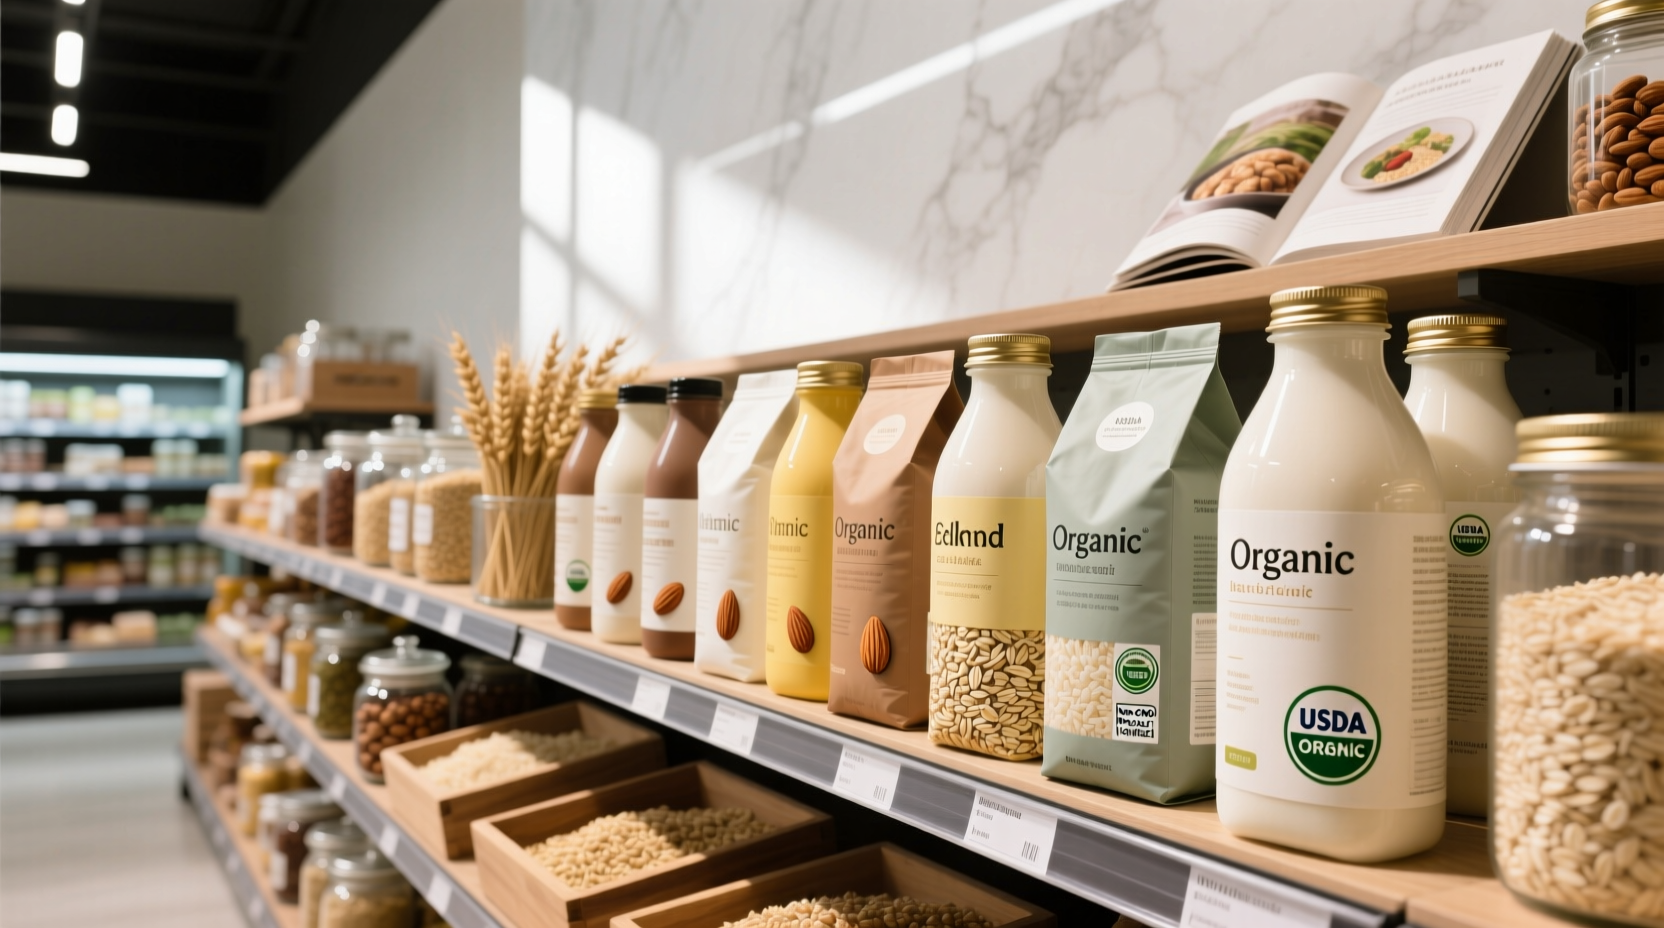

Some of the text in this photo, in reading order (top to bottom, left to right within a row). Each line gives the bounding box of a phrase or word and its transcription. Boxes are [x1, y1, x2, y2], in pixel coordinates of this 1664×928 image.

[835, 516, 895, 545] Organic
[1230, 538, 1355, 580] Organic
[1300, 708, 1367, 734] USDA
